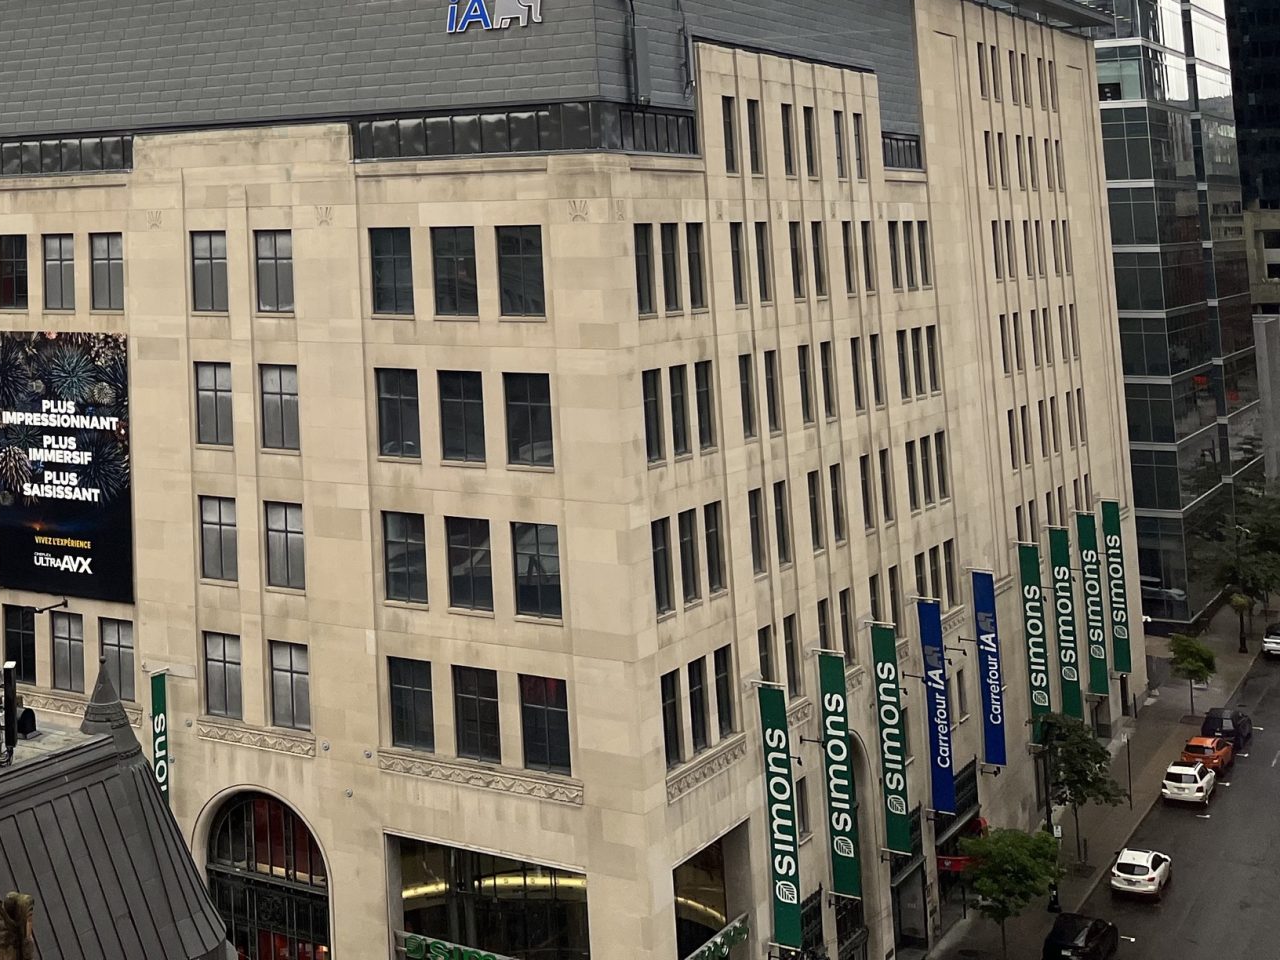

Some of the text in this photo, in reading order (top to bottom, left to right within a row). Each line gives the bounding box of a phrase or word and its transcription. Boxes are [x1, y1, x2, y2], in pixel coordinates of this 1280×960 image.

[2, 411, 119, 431] IMPRESSIONNANT
[41, 399, 76, 414] PLUS
[42, 435, 77, 450] PLUS
[22, 483, 101, 502] SAISISSANT
[28, 448, 92, 465] IMMERSIF
[44, 470, 78, 486] PLUS
[34, 535, 91, 549] VIVEZ L'EXPÉRIENCE
[1106, 534, 1126, 623] simons
[1024, 585, 1047, 688] simons
[1054, 566, 1076, 663] simons
[1082, 549, 1103, 642] simons
[927, 669, 950, 769] Carrefour iA
[979, 633, 1002, 725] Carrefour iA
[824, 692, 852, 832] simons
[876, 661, 904, 791] simons
[765, 727, 796, 877] simons
